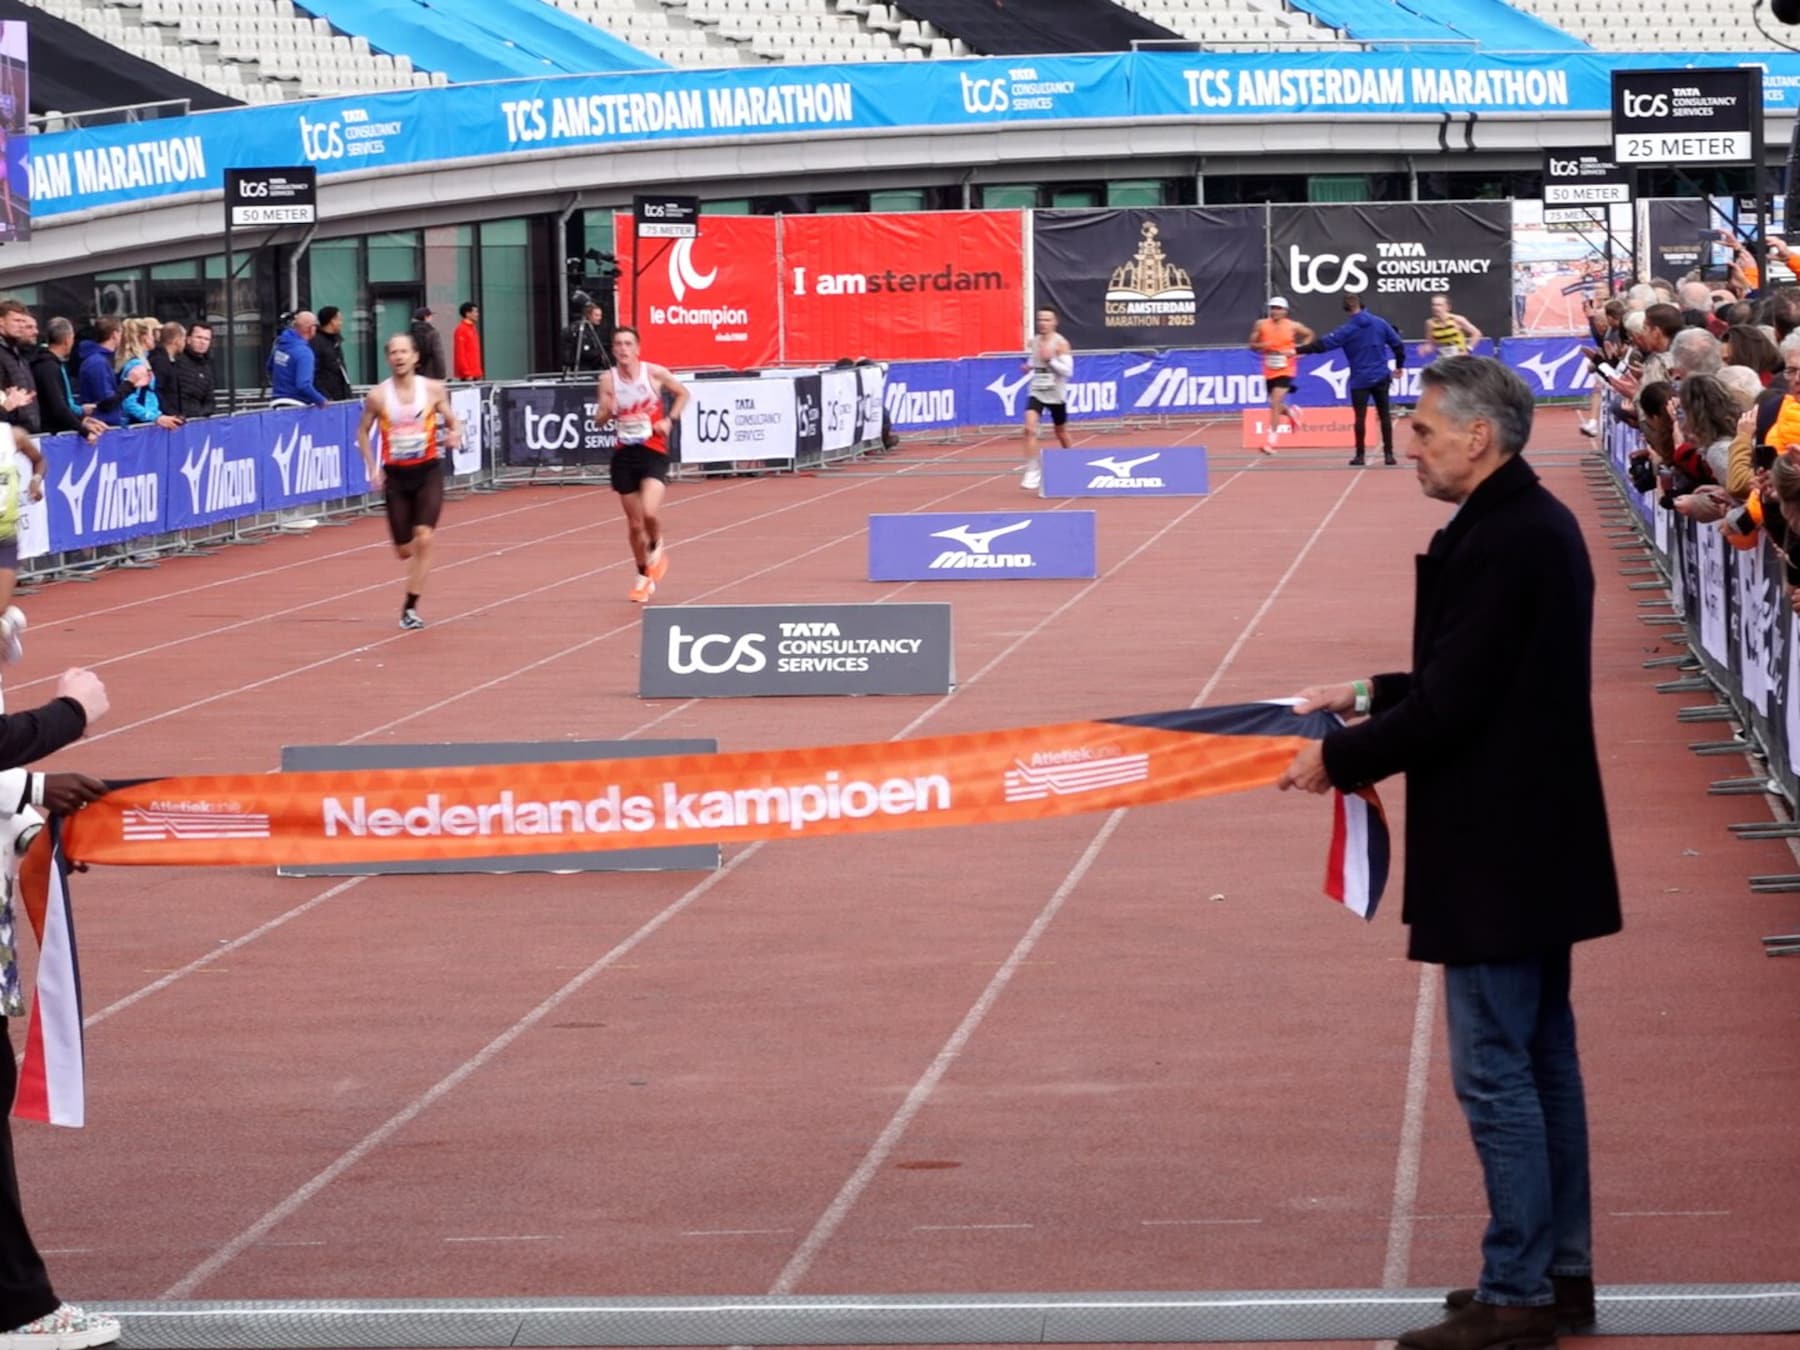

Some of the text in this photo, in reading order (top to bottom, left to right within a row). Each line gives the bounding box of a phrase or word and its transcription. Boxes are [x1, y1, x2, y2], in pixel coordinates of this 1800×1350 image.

[960, 71, 1009, 114] tcs
[1183, 68, 1568, 107] TCS AMSTERDAM MARATHON
[1672, 87, 1701, 97] TATA
[1623, 89, 1669, 118] tcs
[1672, 96, 1737, 107] CONSULTANCY
[502, 83, 853, 143] TCS AMSTERDAM MARATHON
[1672, 106, 1714, 117] SERVICES
[300, 115, 344, 161] tcs
[1627, 137, 1735, 157] 25 METER
[73, 135, 207, 194] MARATHON
[1550, 157, 1579, 176] tcs
[239, 179, 268, 198] tcs
[1552, 187, 1620, 201] 50 METER
[242, 208, 309, 222] 50 METER
[644, 202, 665, 218] tcs
[1376, 242, 1427, 257] TATA
[1290, 244, 1369, 294] tcs
[1376, 259, 1492, 276] CONSULTANCY
[793, 267, 806, 295] I
[1376, 276, 1450, 293] SERVICES
[1104, 300, 1196, 315] tcs AMSTERDAM
[650, 305, 749, 331] le Champion
[1104, 313, 1196, 327] MARATHON 2025
[734, 399, 756, 410] TATA
[525, 404, 581, 450] tcs
[697, 400, 731, 443] tcs
[779, 622, 841, 637] TATA
[667, 624, 767, 675] tcs
[777, 638, 923, 656] CONSULTANCY
[777, 656, 870, 673] SERVICES
[322, 771, 951, 837] Nederlands kampioen
